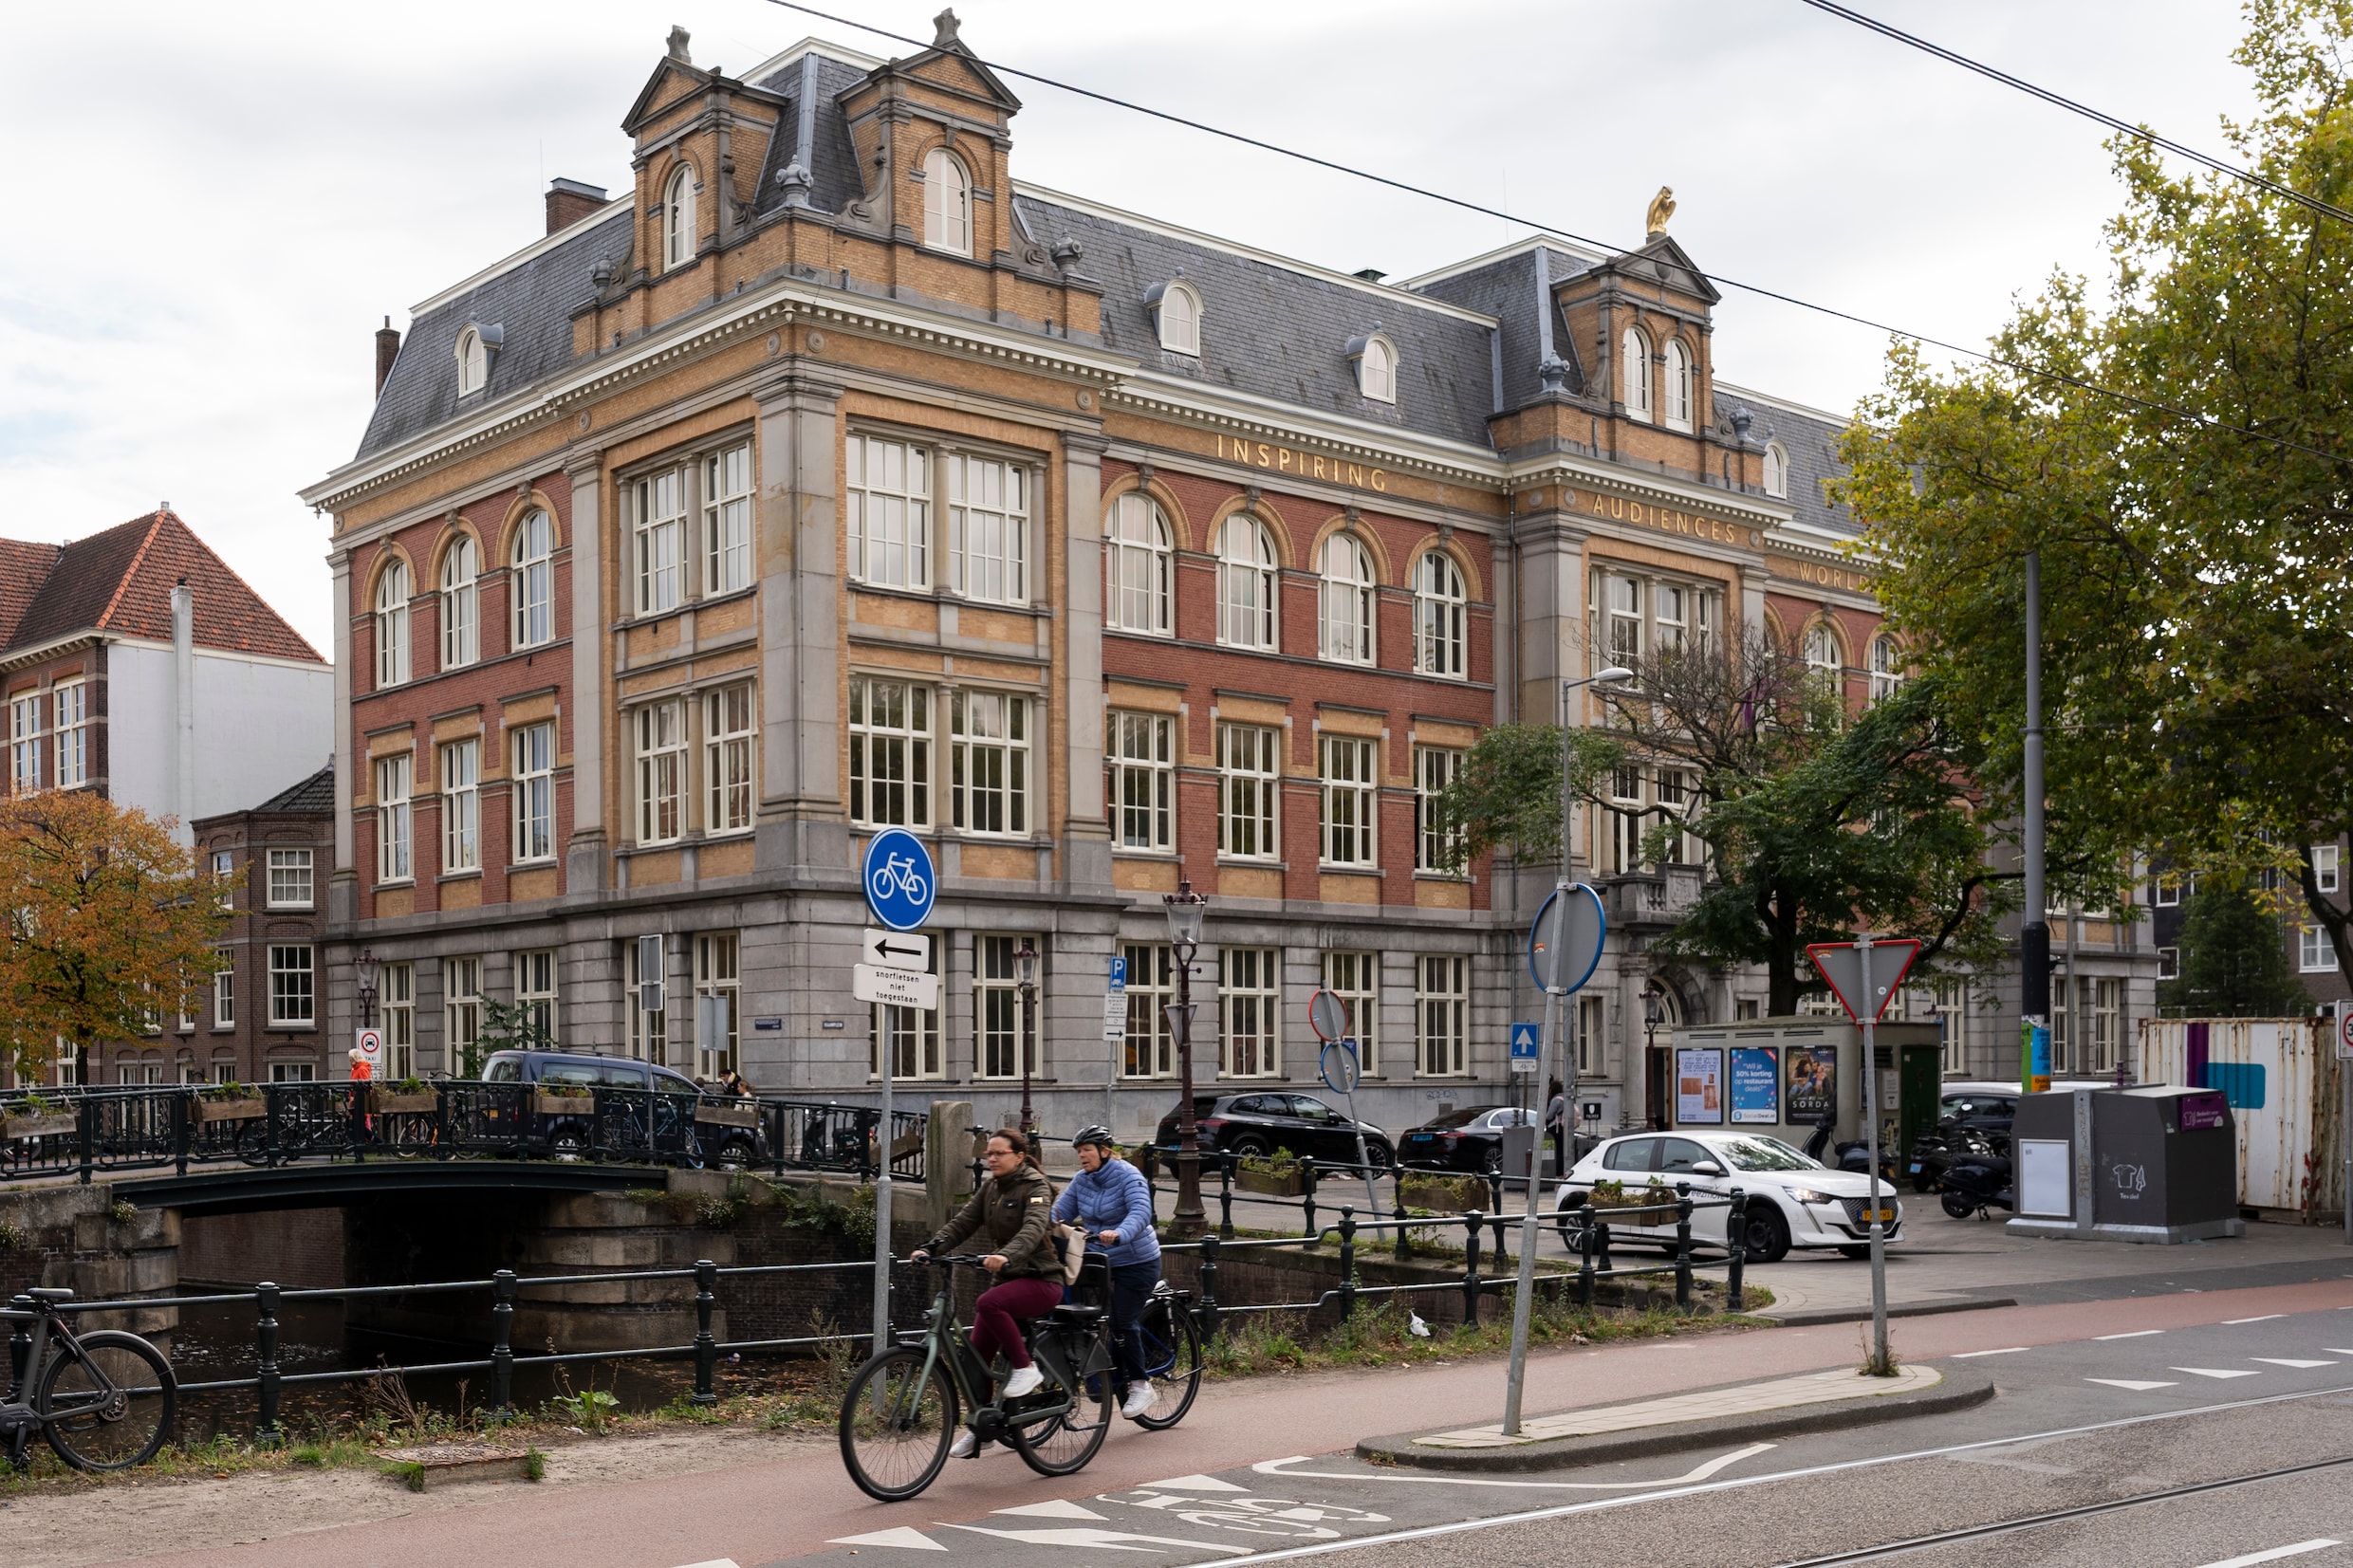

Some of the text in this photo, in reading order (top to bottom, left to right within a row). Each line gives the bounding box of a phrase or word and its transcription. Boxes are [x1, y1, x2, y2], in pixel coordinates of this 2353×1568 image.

[1216, 434, 1386, 492] INSPIRING
[1592, 493, 1735, 544] AUDIENCES
[1114, 959, 1123, 976] P
[876, 970, 919, 983] snorfietsen
[876, 991, 918, 1004] toegestaan
[1792, 1100, 1829, 1109] SORDA
